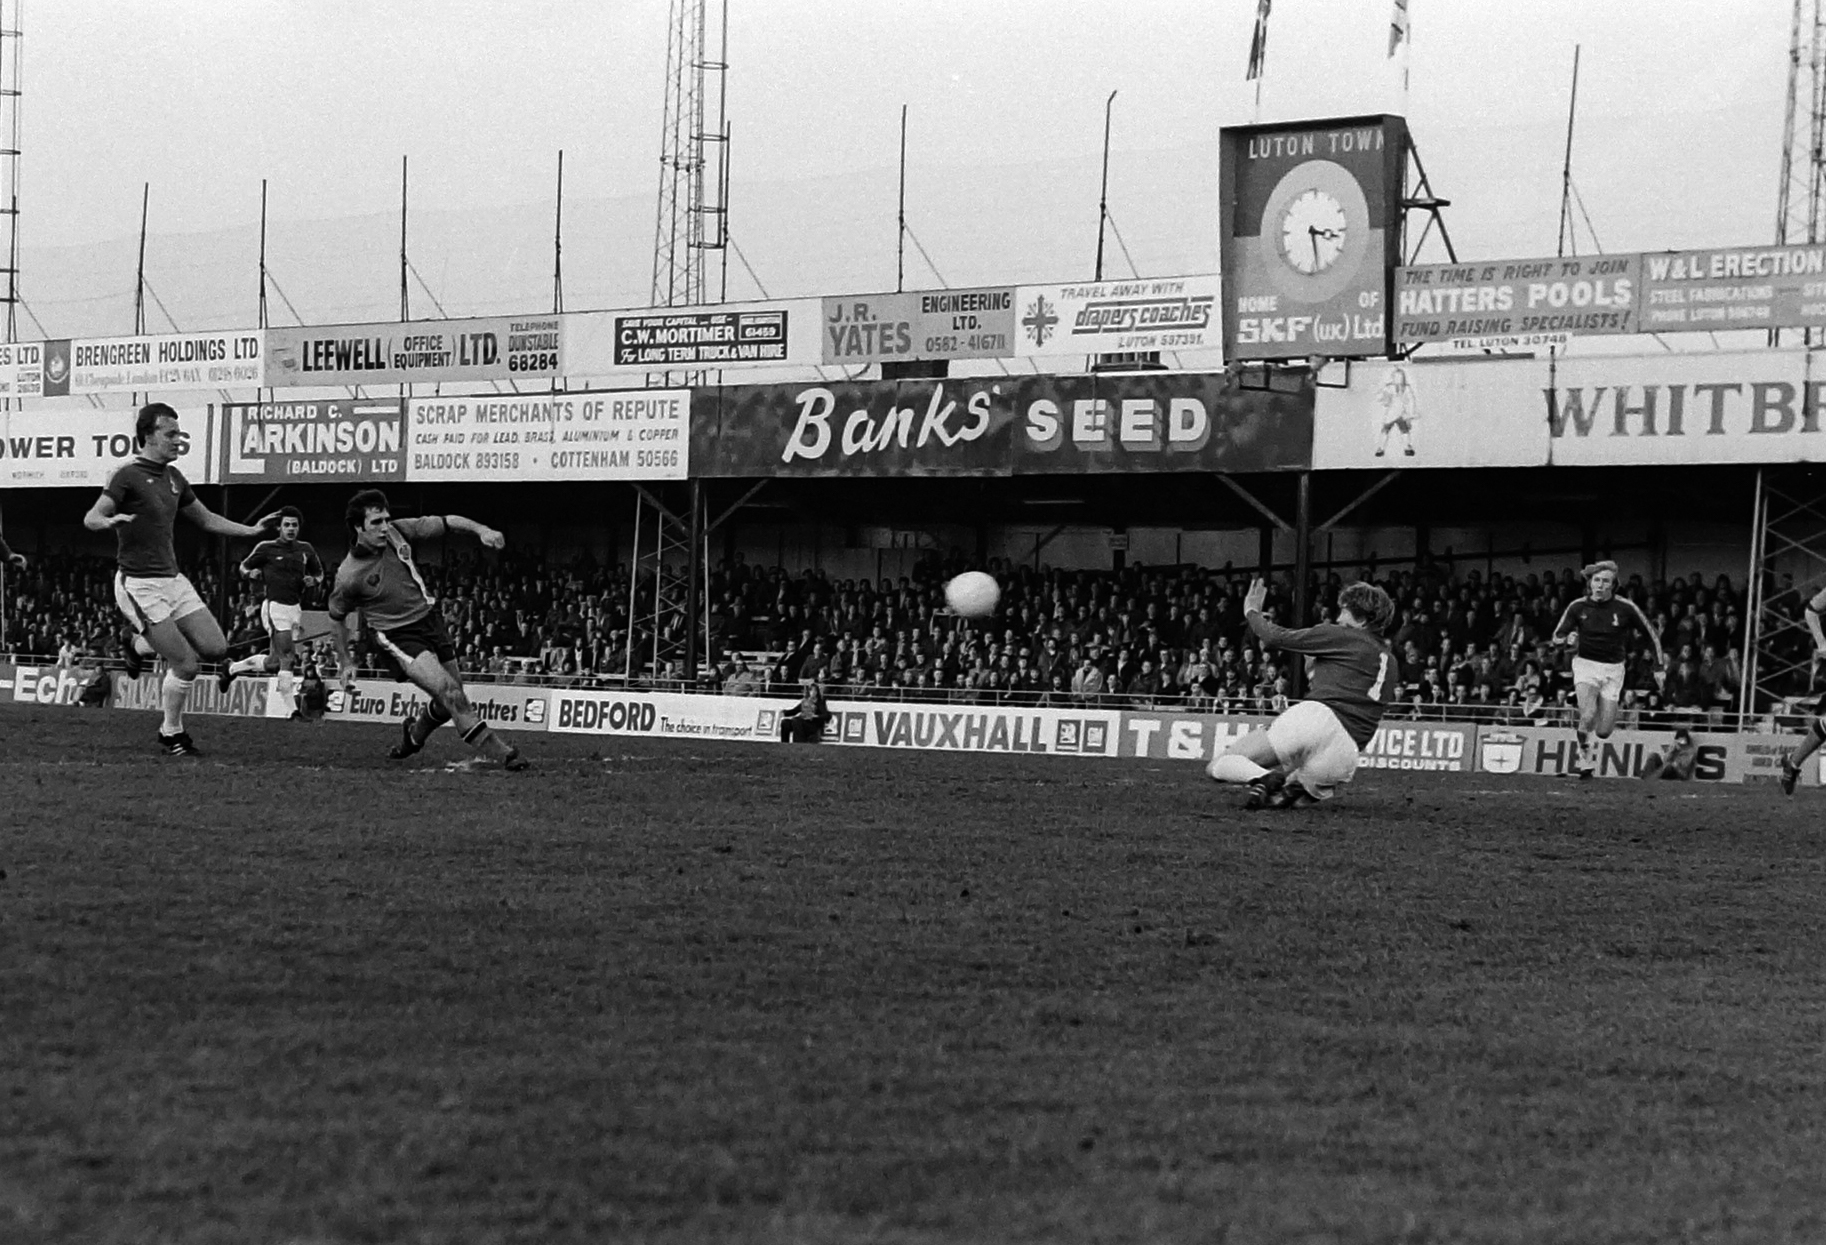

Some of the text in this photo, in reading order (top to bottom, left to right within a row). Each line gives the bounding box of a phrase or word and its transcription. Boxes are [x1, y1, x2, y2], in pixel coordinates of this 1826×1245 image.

[1248, 133, 1314, 159] LUTON
[1405, 259, 1629, 284] THE TIME IS RIGHT TO JOIN
[1710, 250, 1824, 278] ERECTION
[922, 292, 1011, 313] ENGINEERING
[1061, 281, 1184, 300] TRAVEL AWAY WITH
[1237, 291, 1379, 314] HOME OF
[1400, 278, 1633, 315] HATTERS POOLS
[1075, 302, 1212, 331] drapers coaches
[1401, 320, 1440, 337] FUND
[1446, 317, 1511, 335] RAISING
[655, 325, 735, 344] MORTIMER
[829, 322, 912, 356] YATES
[1237, 315, 1312, 344] SKF
[17, 346, 40, 365] LTD
[75, 343, 151, 367] BRENGREEN
[158, 339, 226, 363] HOLDINGS
[302, 338, 386, 372] LEEWELL
[403, 335, 443, 351] OFFICE
[638, 347, 666, 362] LONG
[667, 346, 697, 361] TERM
[394, 351, 450, 370] EQUIPMENT
[508, 352, 558, 372] 68284
[247, 405, 317, 421] RICHARD
[416, 399, 680, 424] SCRAP MERCHANTS OF REPUTE
[1025, 398, 1208, 447] SEED
[0, 433, 190, 459] WER TOS
[415, 433, 438, 445] CASH
[442, 432, 465, 444] PAID
[470, 432, 490, 444] FOR
[638, 428, 679, 441] COPPER
[371, 458, 399, 473] LTD
[414, 452, 470, 470] BALDOCK
[550, 450, 630, 469] COTTENHAM
[1366, 651, 1389, 701] 1
[350, 690, 386, 715] Euro
[389, 691, 431, 718] Exha
[558, 699, 656, 732] BEDFORD
[661, 715, 675, 733] The
[874, 710, 1047, 751] VAUXHALL
[1128, 719, 1161, 757] T
[1167, 720, 1205, 759] &
[1420, 730, 1465, 758] LTD
[1357, 756, 1461, 771] DISCOUNTS
